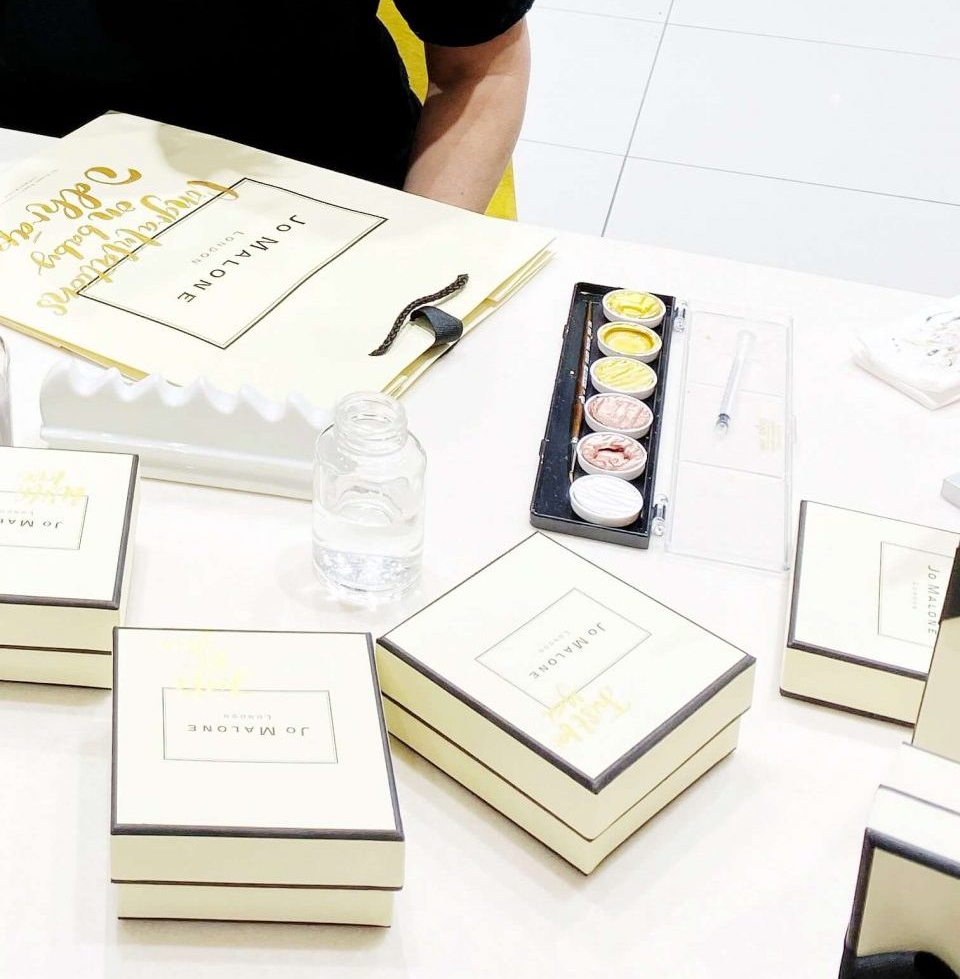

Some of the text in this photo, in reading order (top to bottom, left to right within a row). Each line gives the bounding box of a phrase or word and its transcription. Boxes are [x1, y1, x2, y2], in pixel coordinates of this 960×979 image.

[30, 224, 110, 276] baby
[177, 236, 280, 303] MALONE
[191, 230, 246, 264] LONDON
[927, 584, 941, 635] MALONE
[529, 636, 590, 679] MALONE
[188, 724, 276, 736] MALONE
